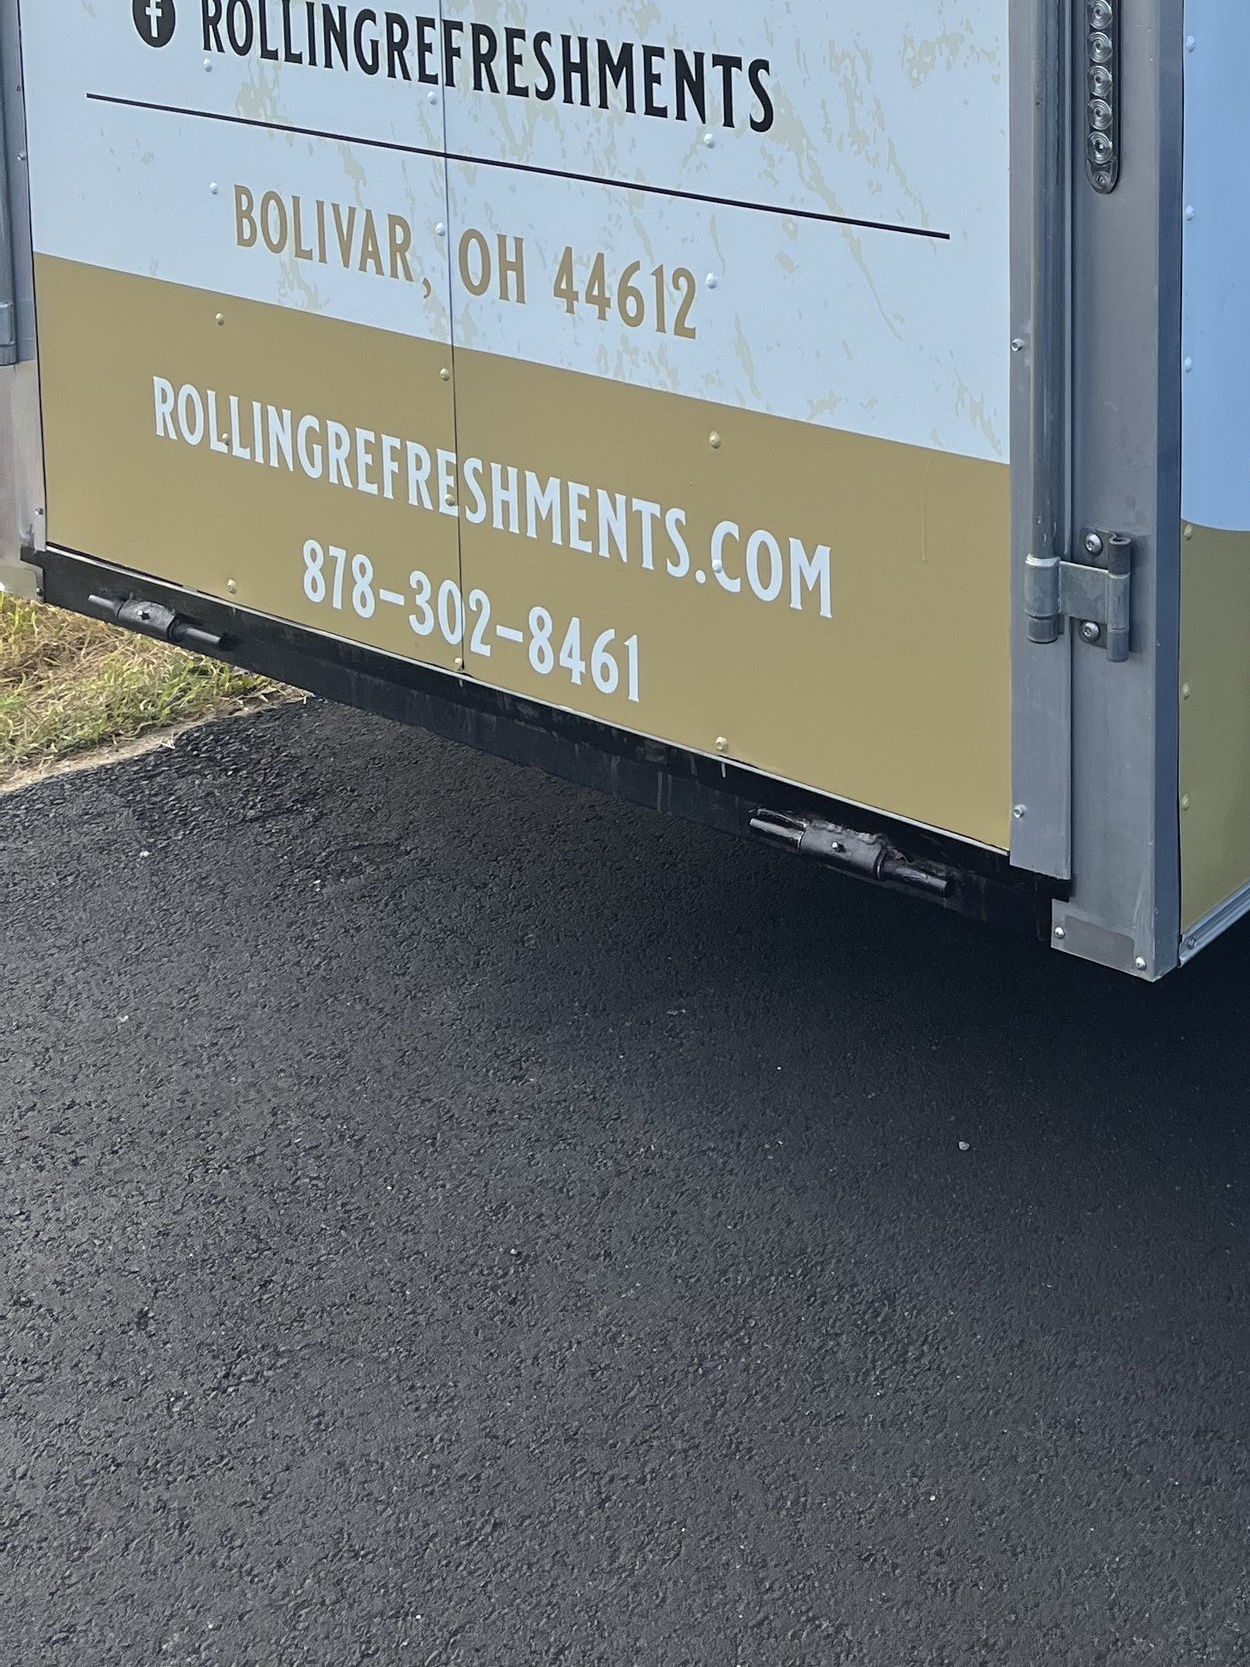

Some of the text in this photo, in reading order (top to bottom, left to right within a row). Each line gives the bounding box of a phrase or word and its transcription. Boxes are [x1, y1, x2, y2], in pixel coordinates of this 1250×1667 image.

[233, 184, 697, 339] BOLIVAR, OH 44612
[153, 376, 832, 619] ROLLINGREFRESHMENTS.COM
[303, 539, 640, 703] 878-302-8461
